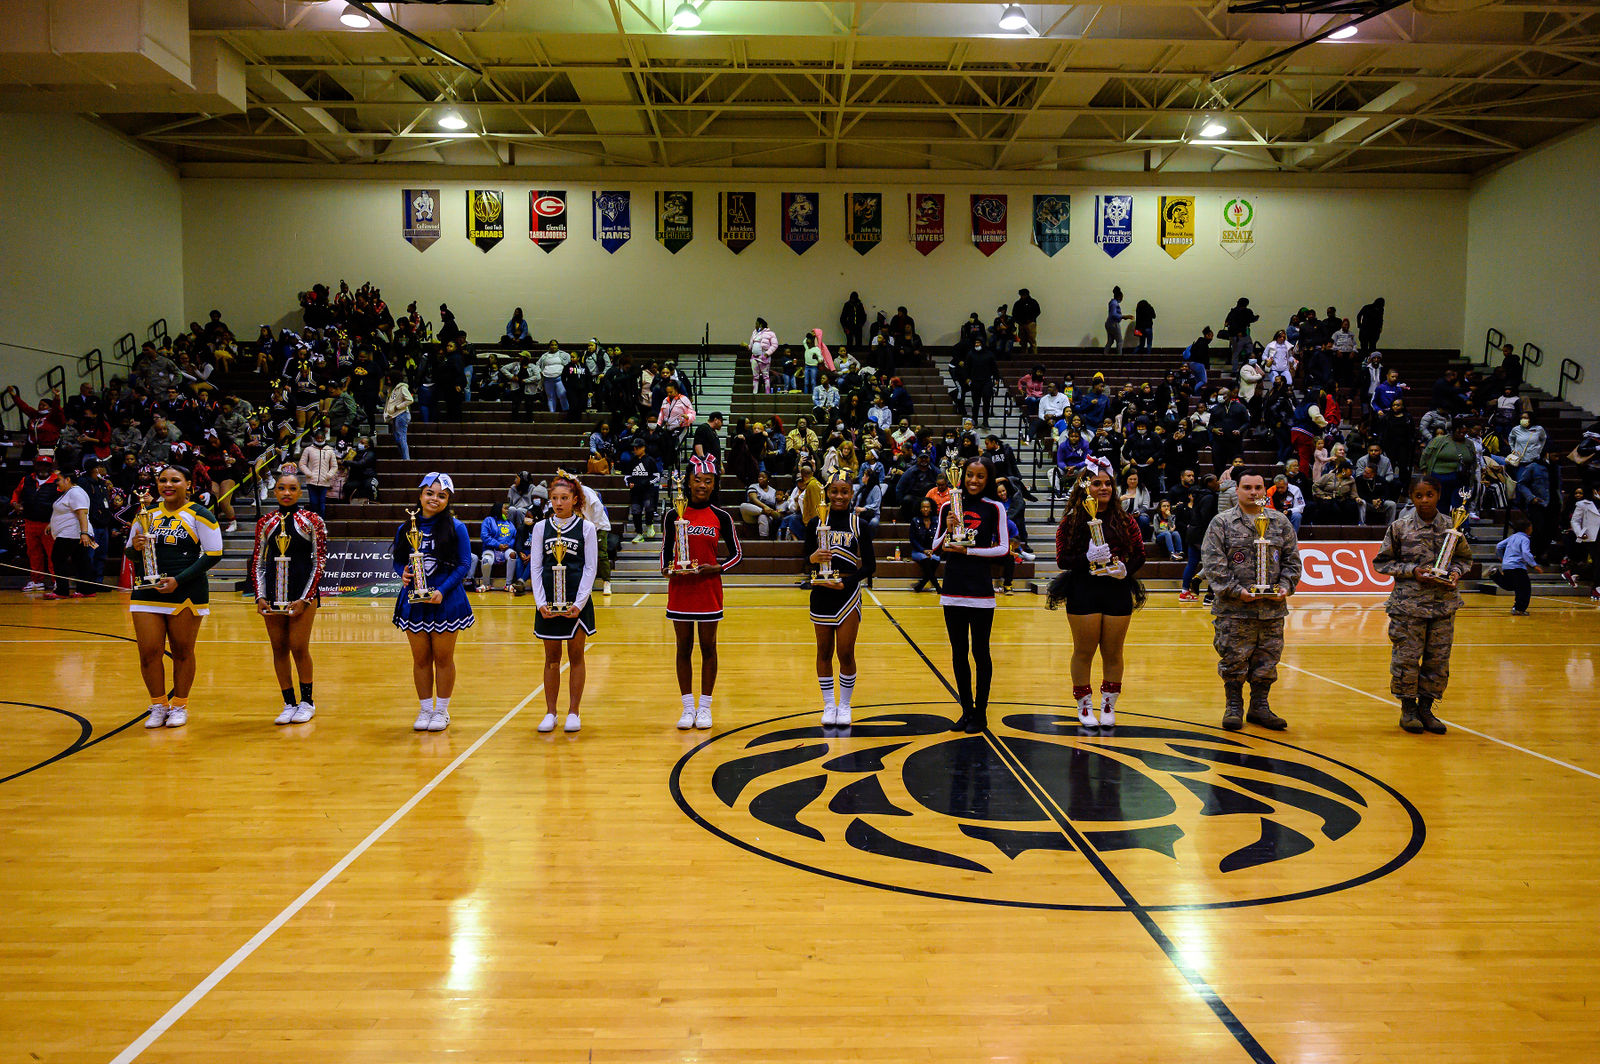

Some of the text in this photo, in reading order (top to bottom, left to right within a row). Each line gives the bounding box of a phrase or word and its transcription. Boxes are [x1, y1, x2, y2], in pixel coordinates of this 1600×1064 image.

[600, 232, 630, 240] RAMS
[1222, 231, 1252, 240] SENATE
[1097, 236, 1132, 244] LAKERS
[687, 525, 716, 537] ears
